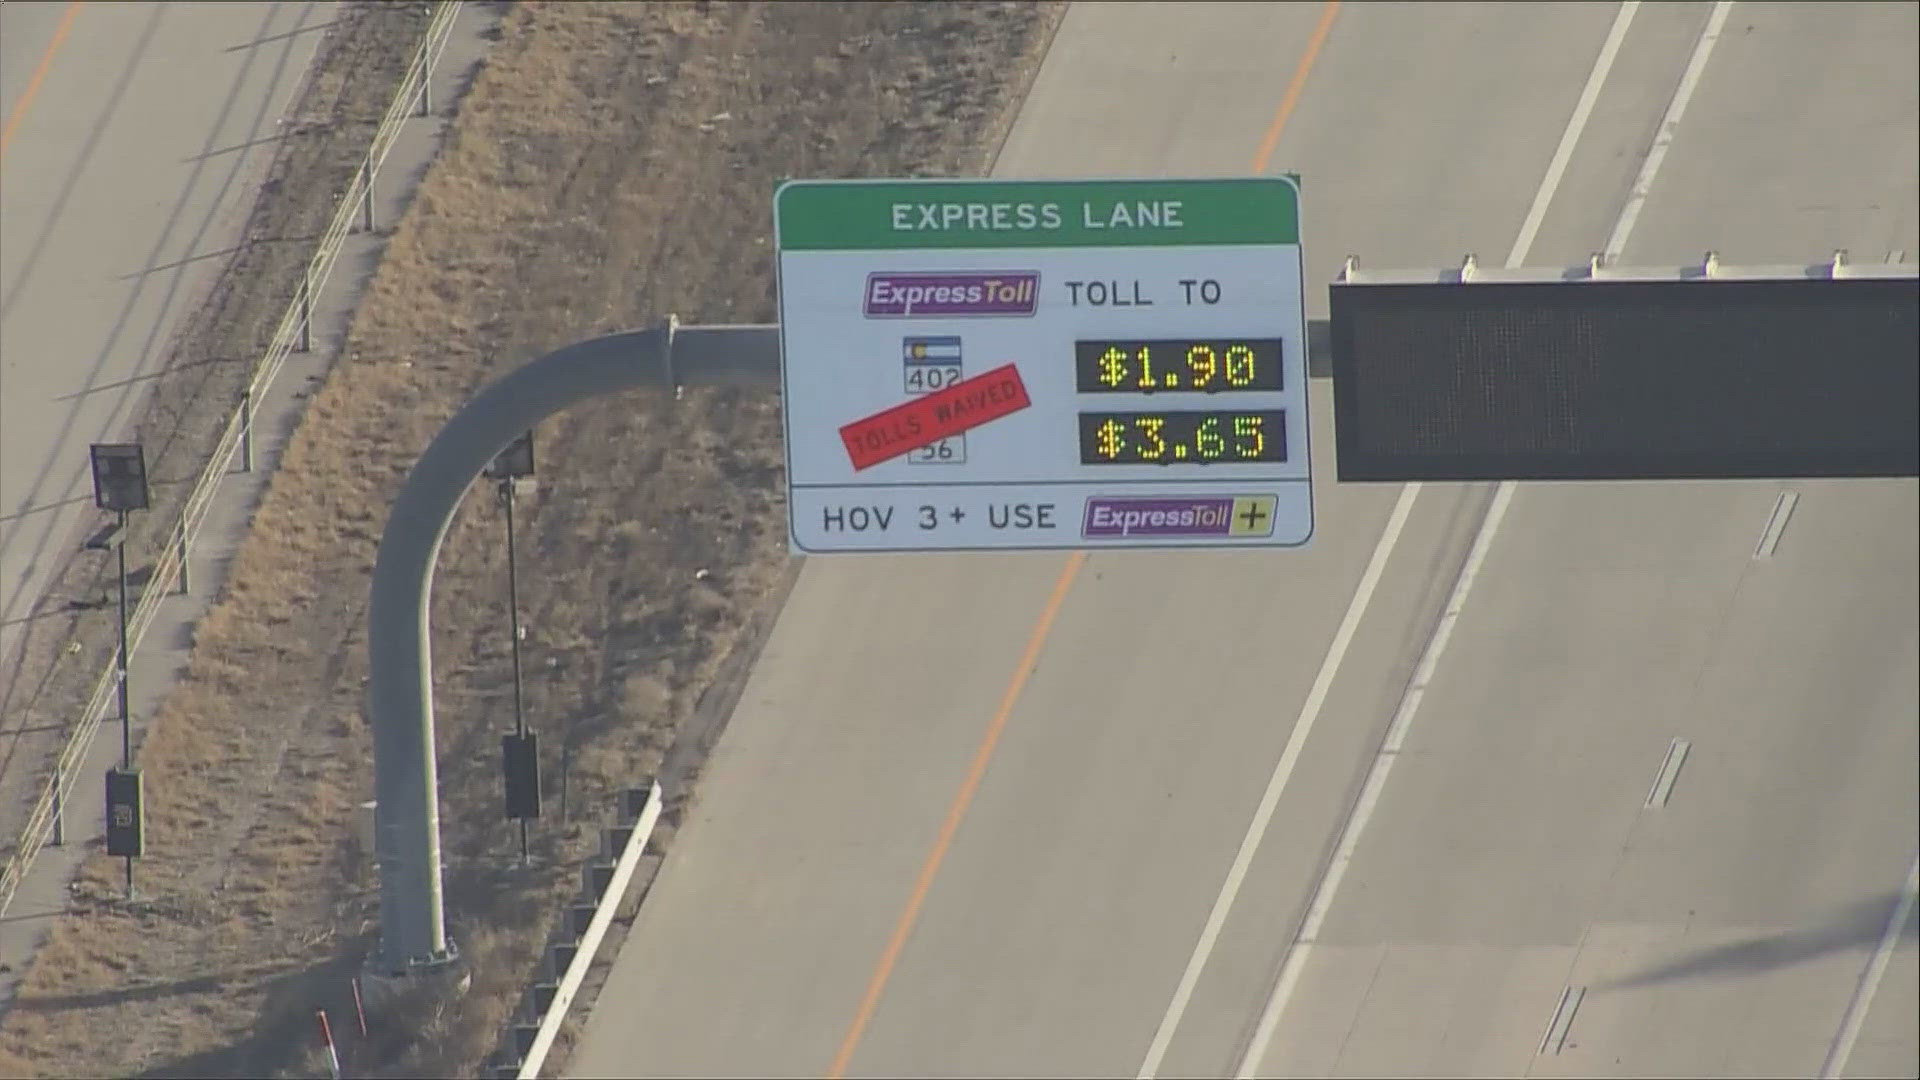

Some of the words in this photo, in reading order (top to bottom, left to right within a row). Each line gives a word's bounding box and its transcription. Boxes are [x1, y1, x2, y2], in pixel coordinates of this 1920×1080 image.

[892, 203, 1062, 230] EXPRESS
[1084, 201, 1184, 228] LANE
[870, 277, 1033, 317] ExpressToll
[1065, 280, 1153, 306] TOLL
[1179, 279, 1222, 304] TO
[909, 368, 960, 390] 402
[1099, 345, 1255, 387] $1.90
[852, 413, 922, 455] TOLLS
[934, 380, 1017, 423] WAIVED
[1097, 416, 1264, 459] $3.65
[823, 505, 894, 532] HOV
[988, 503, 1057, 529] USE
